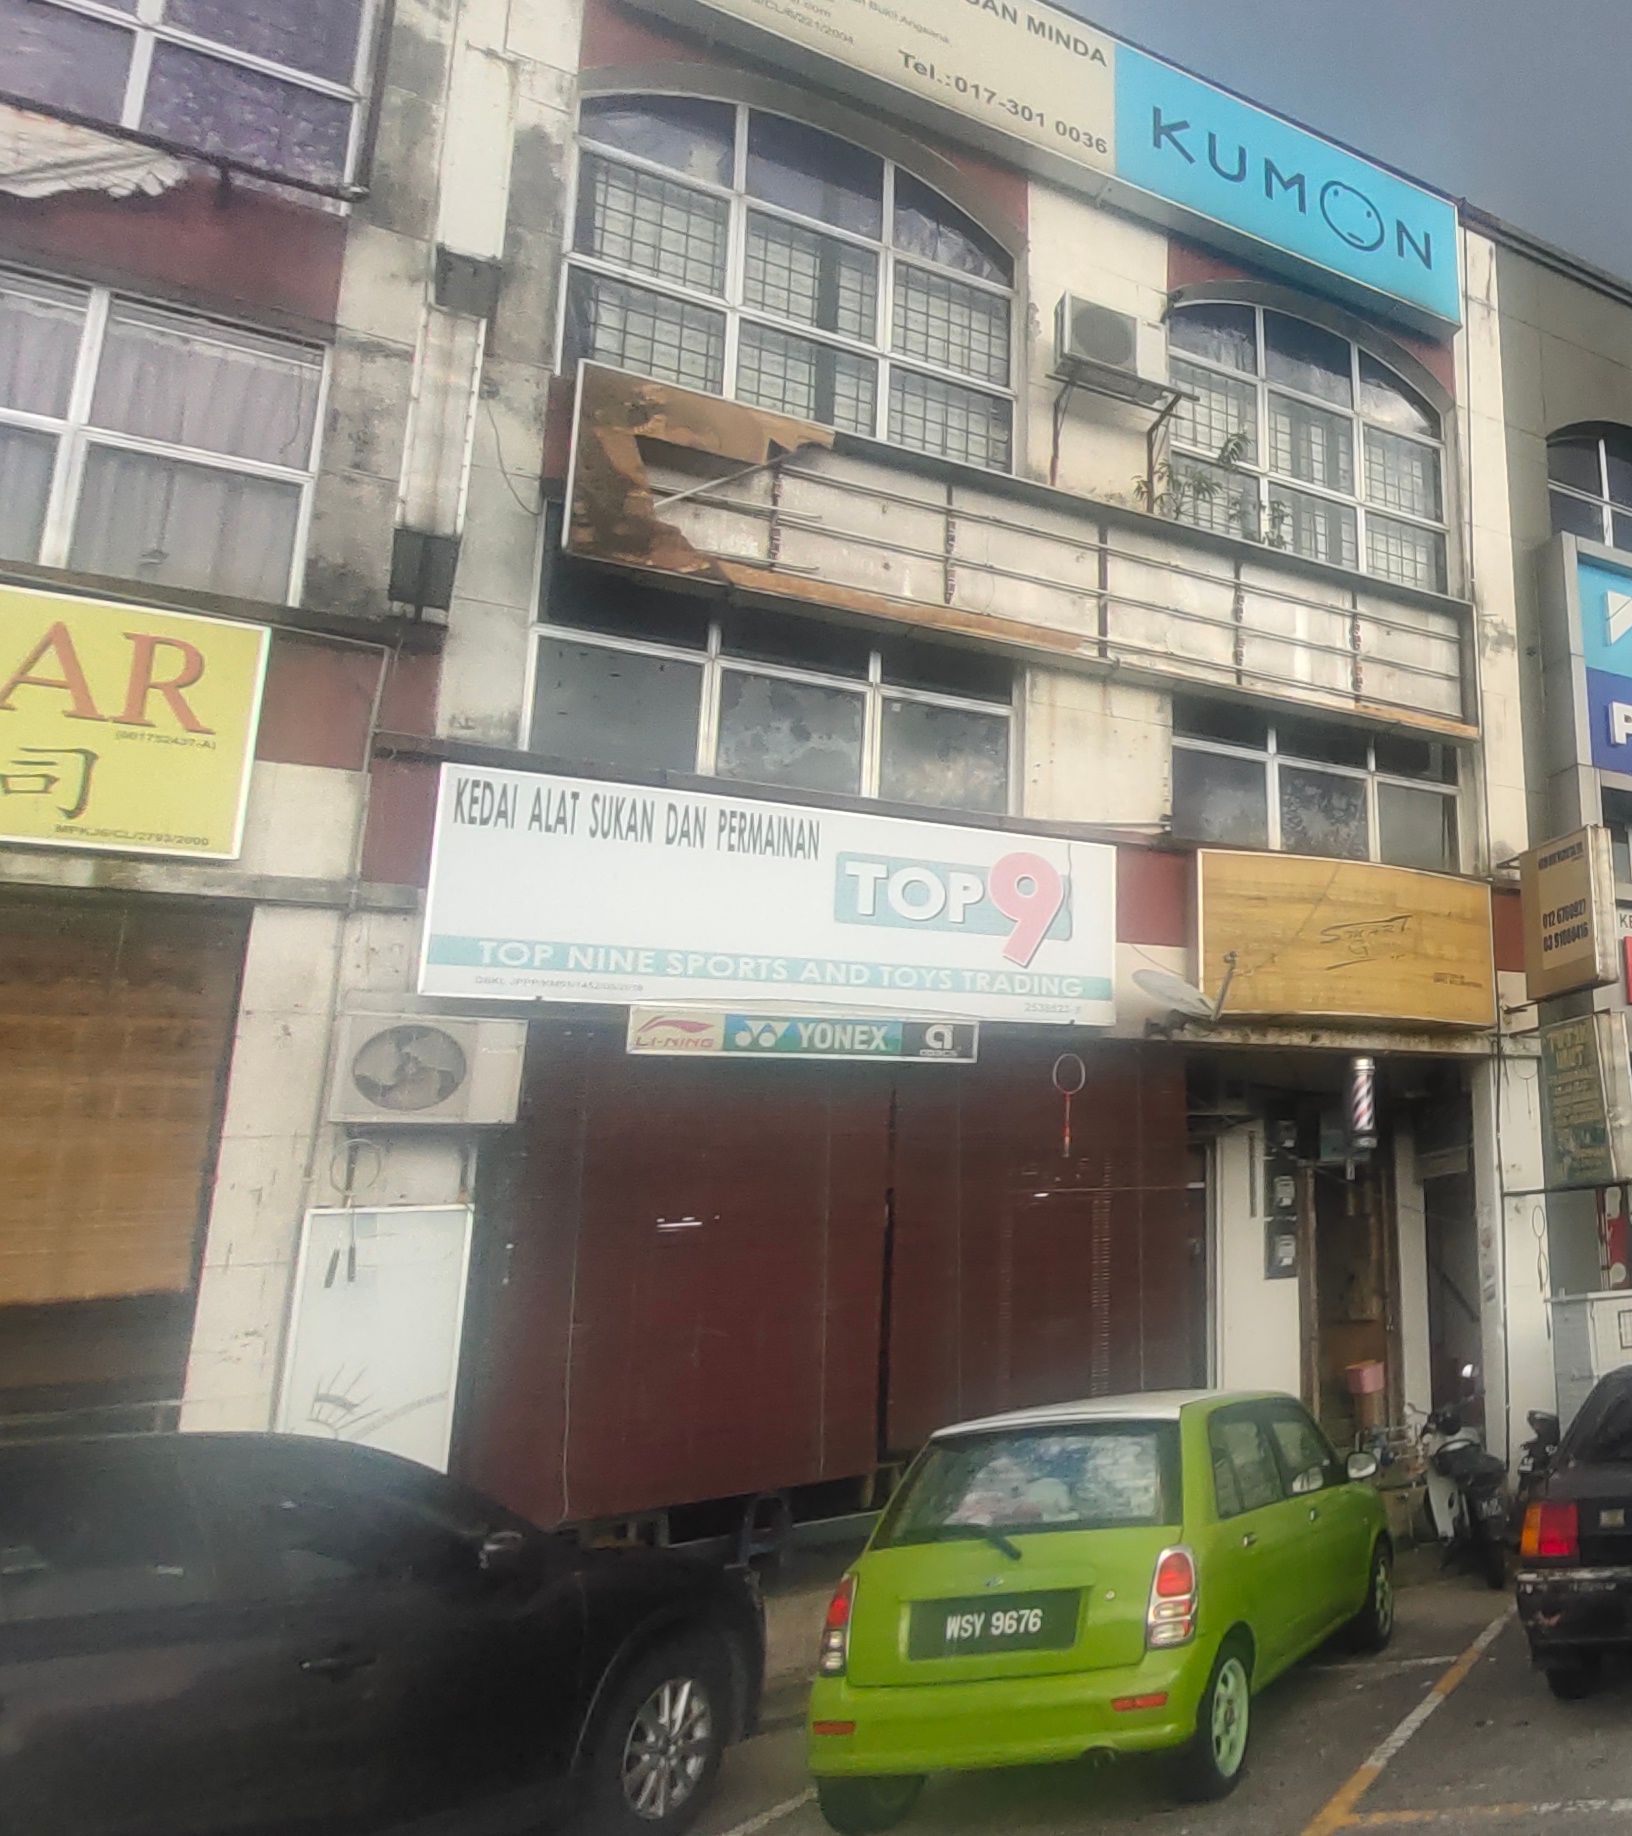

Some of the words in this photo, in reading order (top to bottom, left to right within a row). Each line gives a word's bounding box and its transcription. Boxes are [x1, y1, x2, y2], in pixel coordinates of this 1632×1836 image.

[965, 0, 1018, 24] AN
[1026, 15, 1108, 68] MINDA
[1055, 120, 1108, 154] 0036
[1151, 106, 1434, 271] KUMON
[453, 777, 518, 829] KEDAI
[528, 787, 581, 836] ALAT
[589, 795, 654, 844] SUKAN
[665, 804, 707, 850] DAN
[716, 811, 821, 861] PERMAINAN
[478, 939, 551, 969] TOP
[567, 947, 655, 976] NINE
[665, 953, 787, 983] SPORTS
[799, 960, 871, 986] AND
[880, 967, 953, 992] TOYS
[960, 971, 1084, 1000] TRADING
[634, 1034, 716, 1049] LI-NING
[797, 1021, 890, 1052] YONEX
[945, 1611, 984, 1640] WSY
[991, 1609, 1043, 1636] 9676
